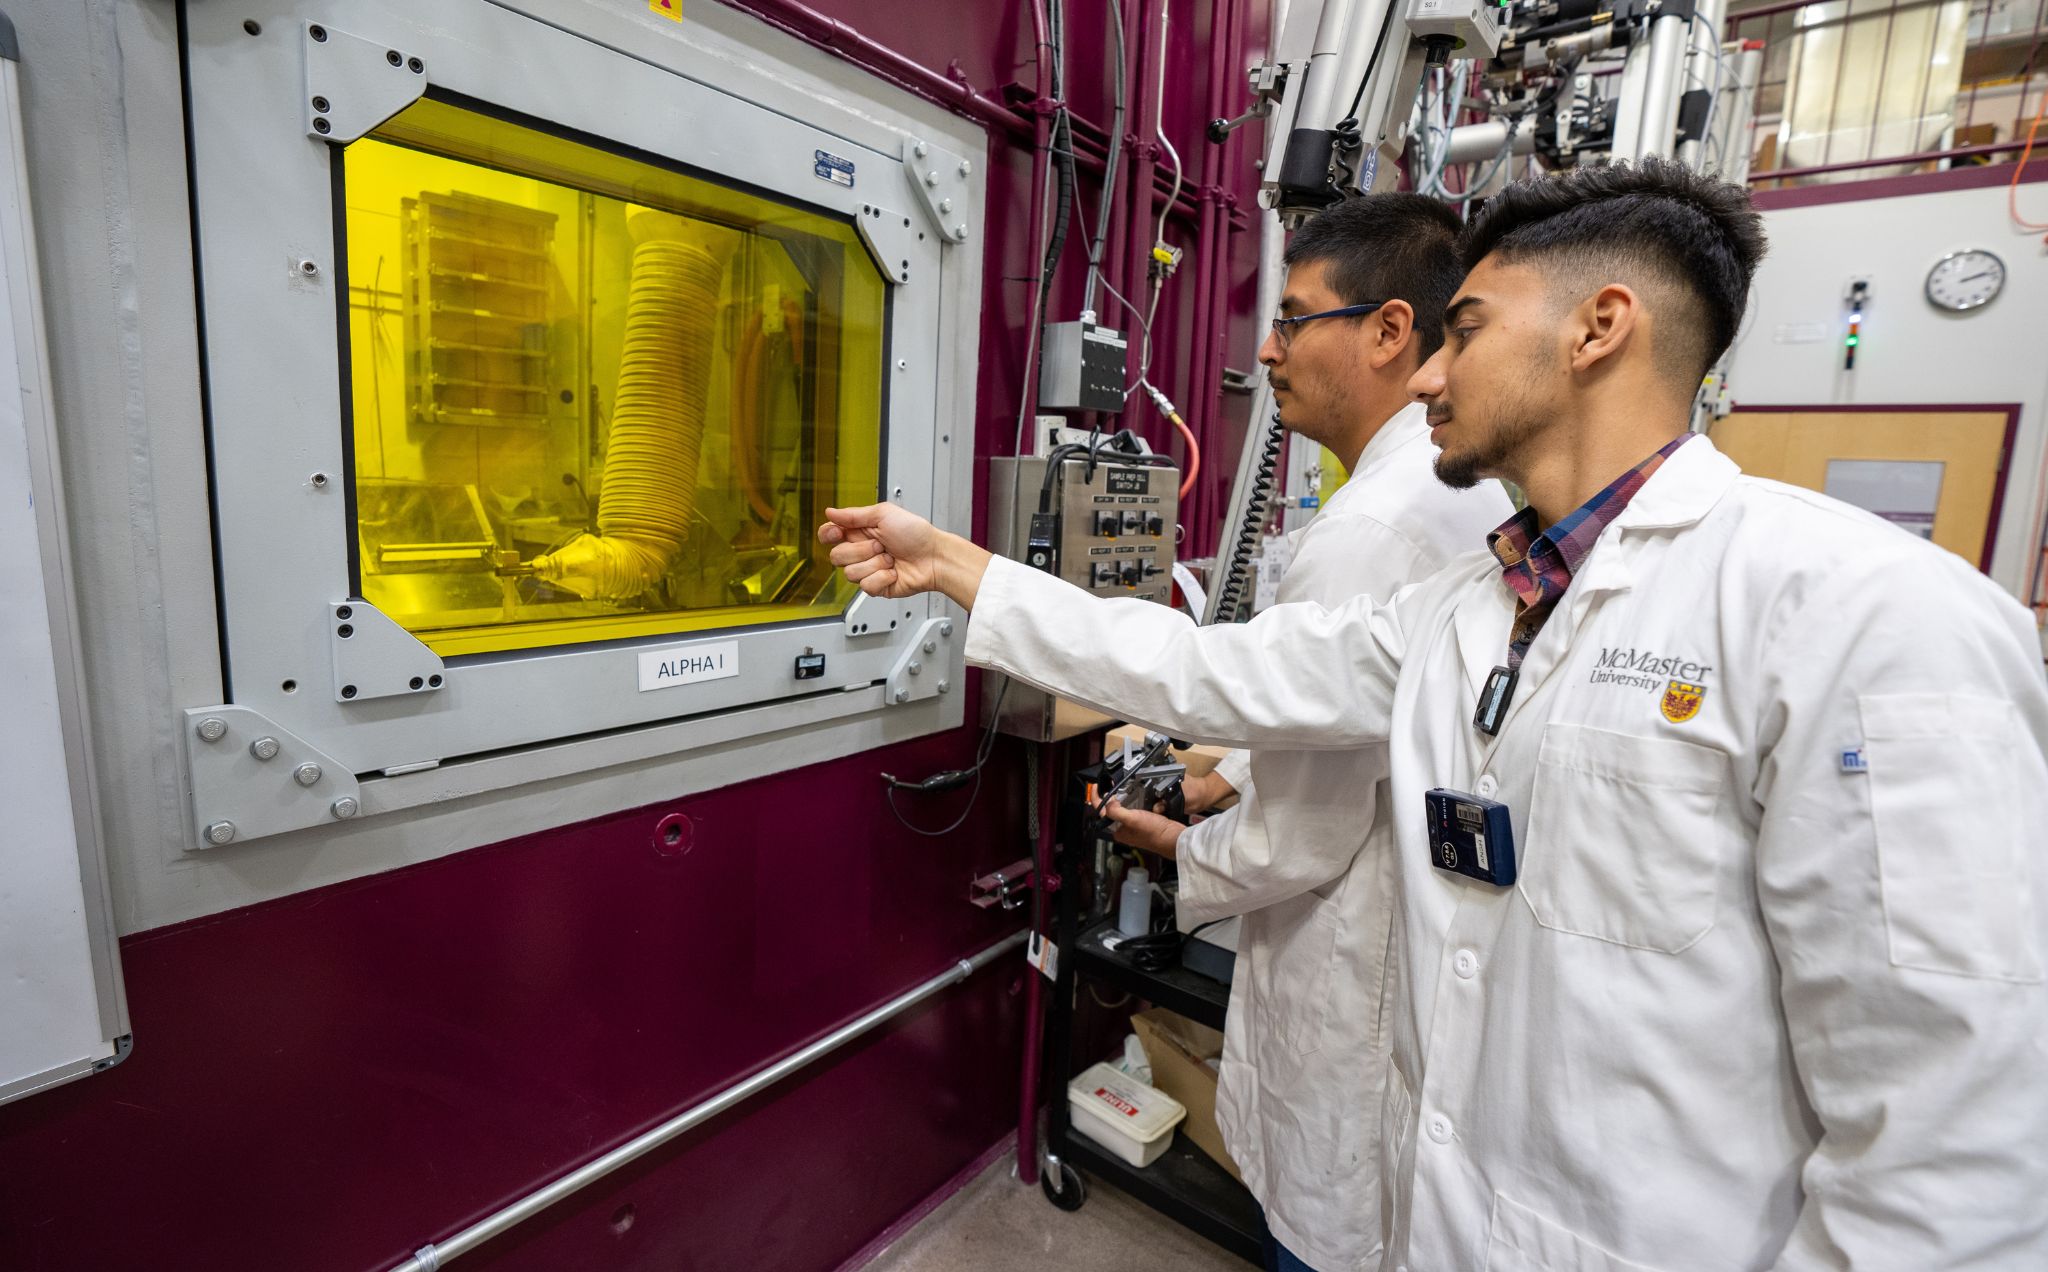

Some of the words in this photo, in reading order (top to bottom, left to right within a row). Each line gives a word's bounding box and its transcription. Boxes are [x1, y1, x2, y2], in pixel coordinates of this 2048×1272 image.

[1110, 472, 1126, 481] SAMPLE
[658, 655, 715, 679] ALPHA
[719, 653, 724, 669] I
[1594, 647, 1713, 683] McMaster
[1589, 669, 1663, 694] University
[1102, 1091, 1134, 1114] ULINE
